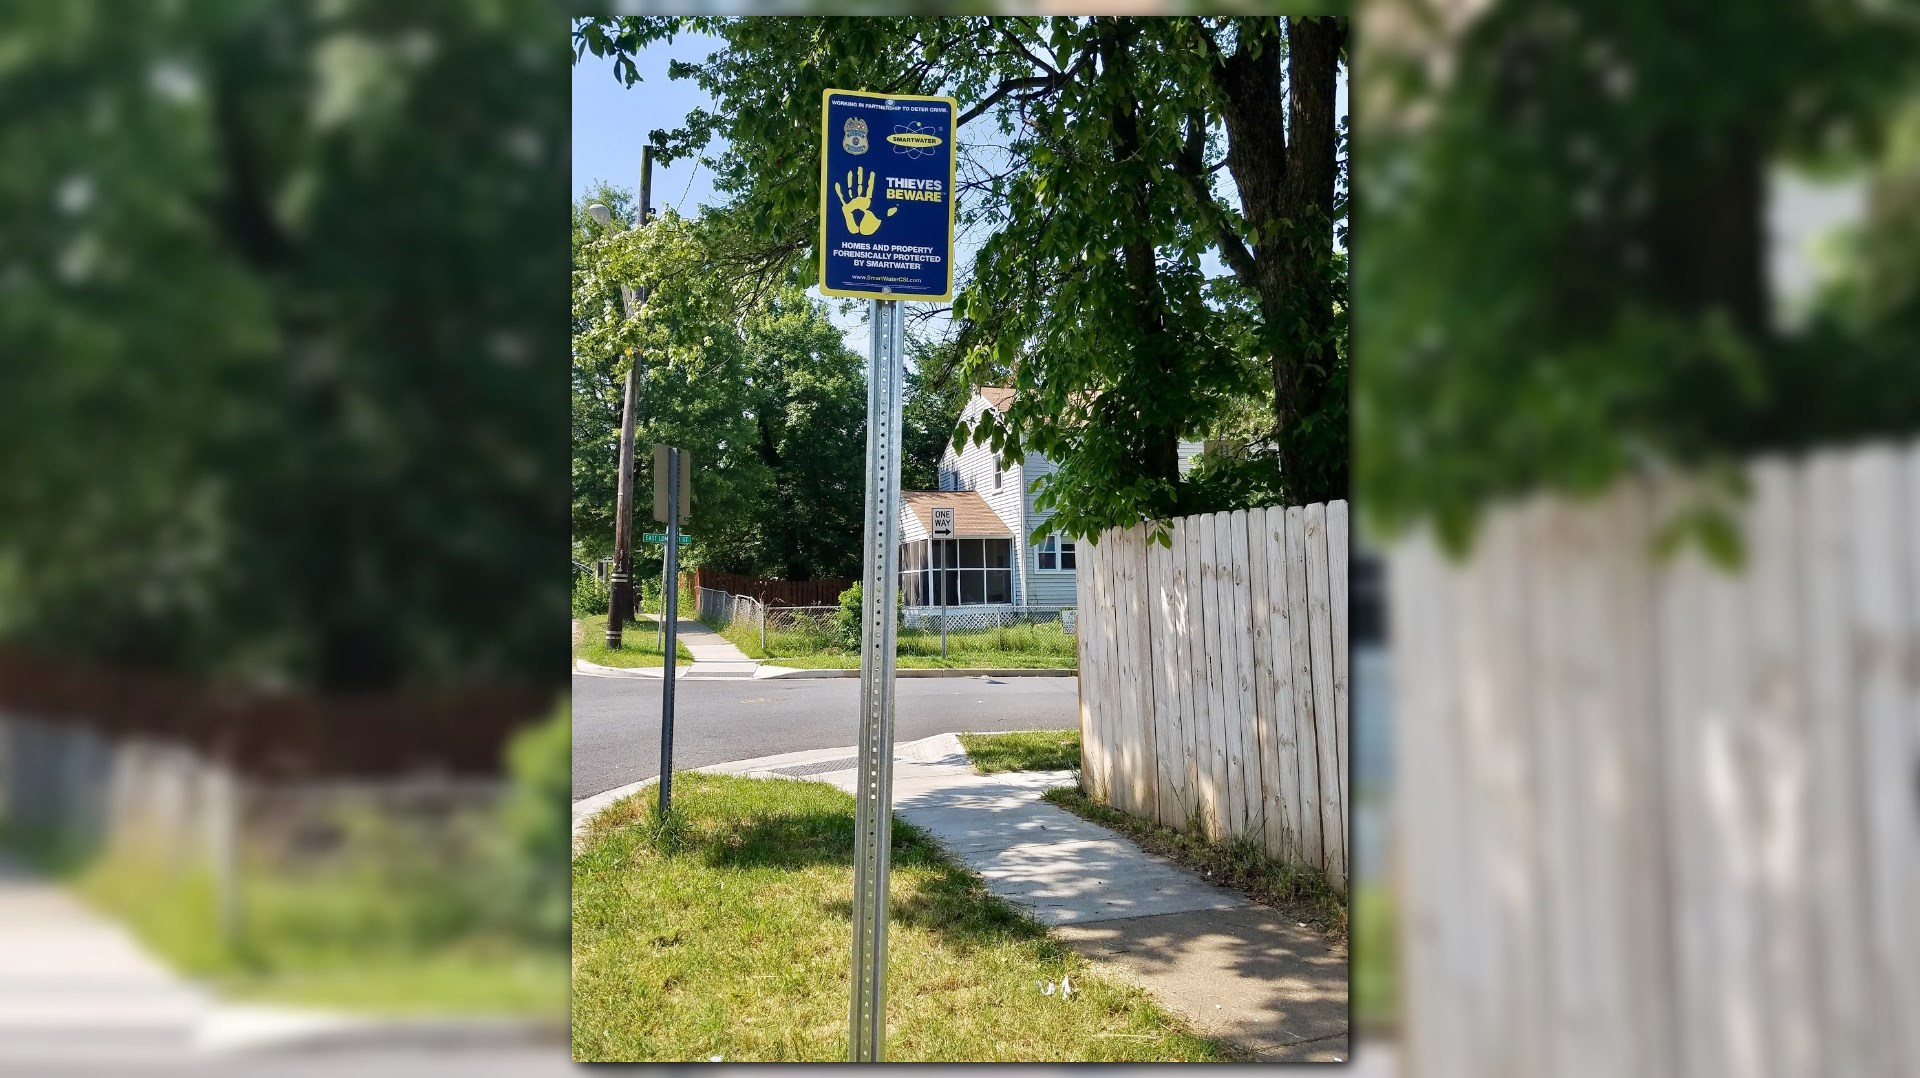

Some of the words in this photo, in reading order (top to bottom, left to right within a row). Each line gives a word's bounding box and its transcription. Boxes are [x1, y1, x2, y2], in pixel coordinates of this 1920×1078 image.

[831, 100, 857, 108] WORKING
[865, 103, 902, 111] PARTNERSHIP
[892, 136, 937, 144] SMARTWATER
[885, 177, 943, 191] THIEVES
[885, 189, 942, 203] BEWARE
[841, 242, 871, 251] HOMES
[872, 243, 890, 252] AND
[891, 245, 934, 254] PROPERTY
[832, 249, 892, 260] FORENSICALLY
[893, 253, 941, 263] PROTECTED
[853, 259, 864, 267] BY
[866, 260, 921, 270] SMARTWATER
[935, 510, 951, 518] ONE
[934, 519, 951, 527] WAY
